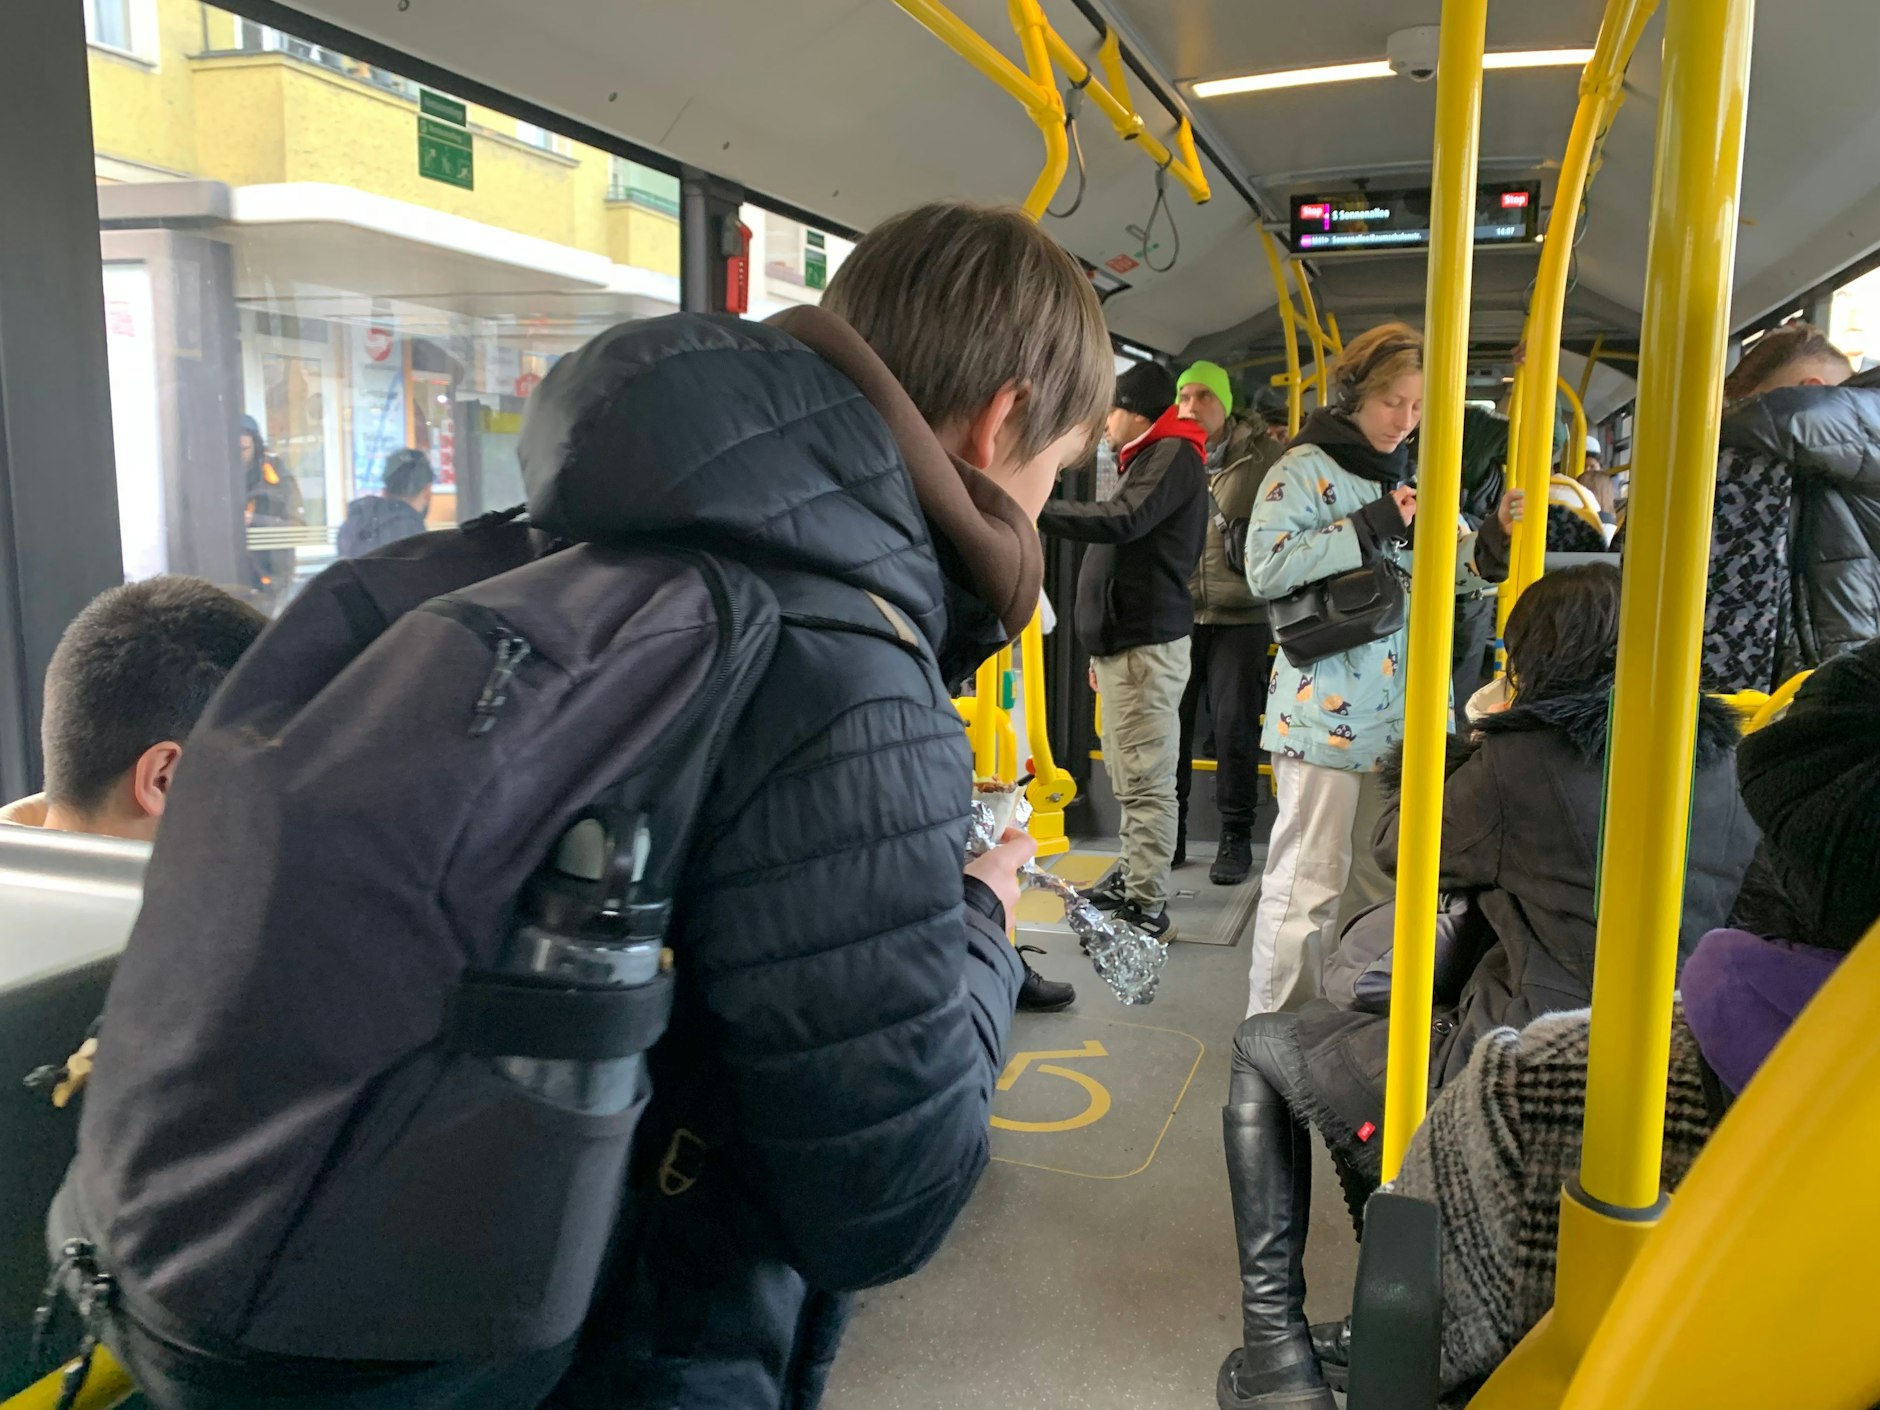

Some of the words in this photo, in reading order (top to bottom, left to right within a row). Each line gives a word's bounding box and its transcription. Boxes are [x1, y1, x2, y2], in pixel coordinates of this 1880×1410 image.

[1504, 194, 1525, 207] Stop
[1303, 206, 1323, 218] Stop
[1339, 207, 1390, 220] Sonnenallee
